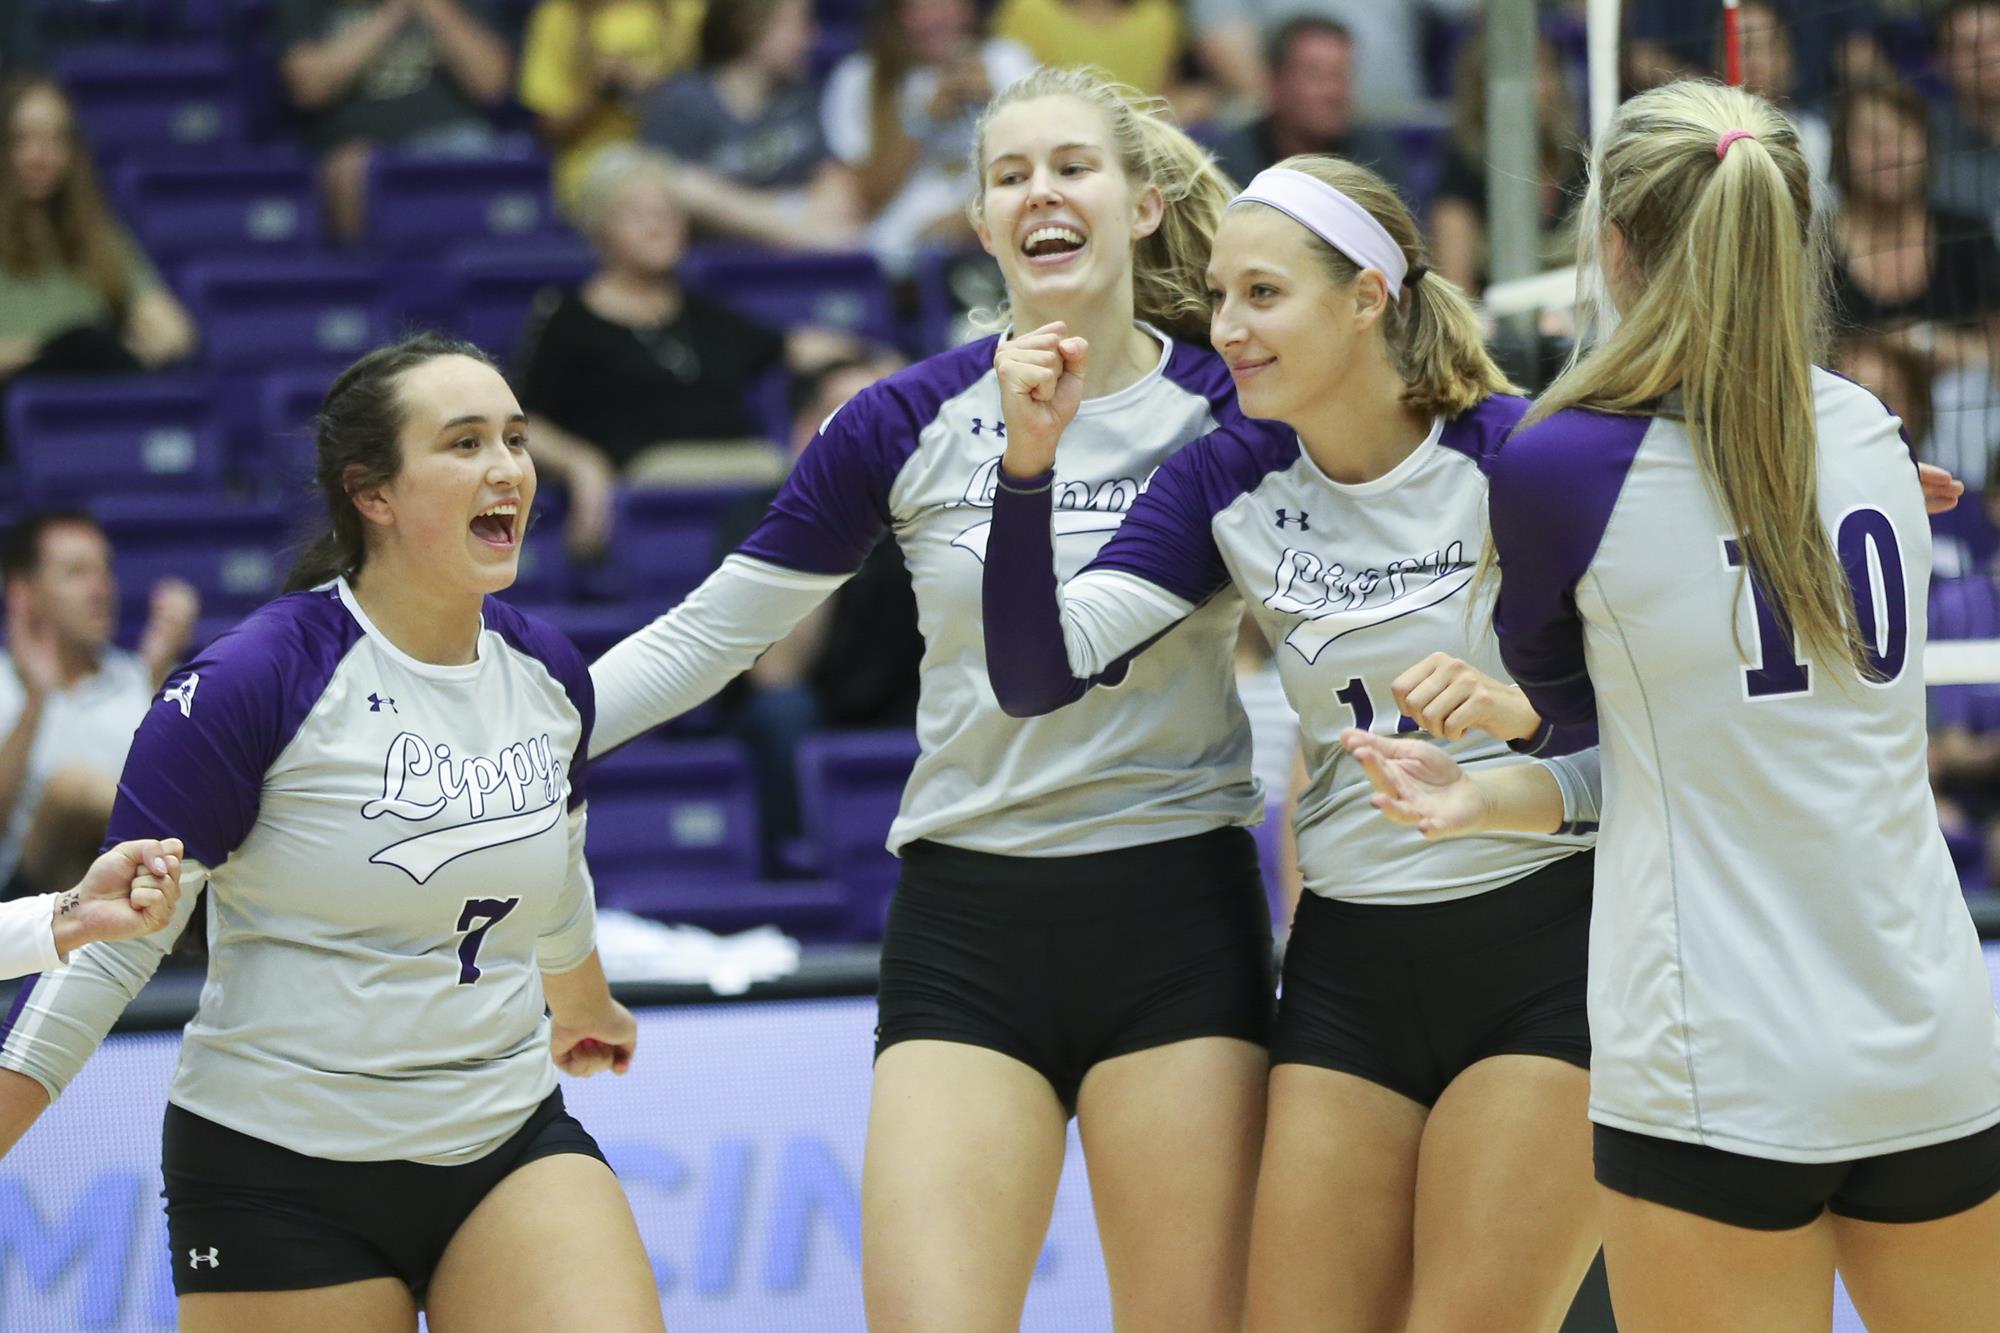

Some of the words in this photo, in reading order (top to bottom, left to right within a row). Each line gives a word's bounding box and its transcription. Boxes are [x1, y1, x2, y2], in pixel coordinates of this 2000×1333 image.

[1717, 503, 1909, 703] 10
[361, 731, 564, 821] Lippy
[456, 895, 523, 986] 7
